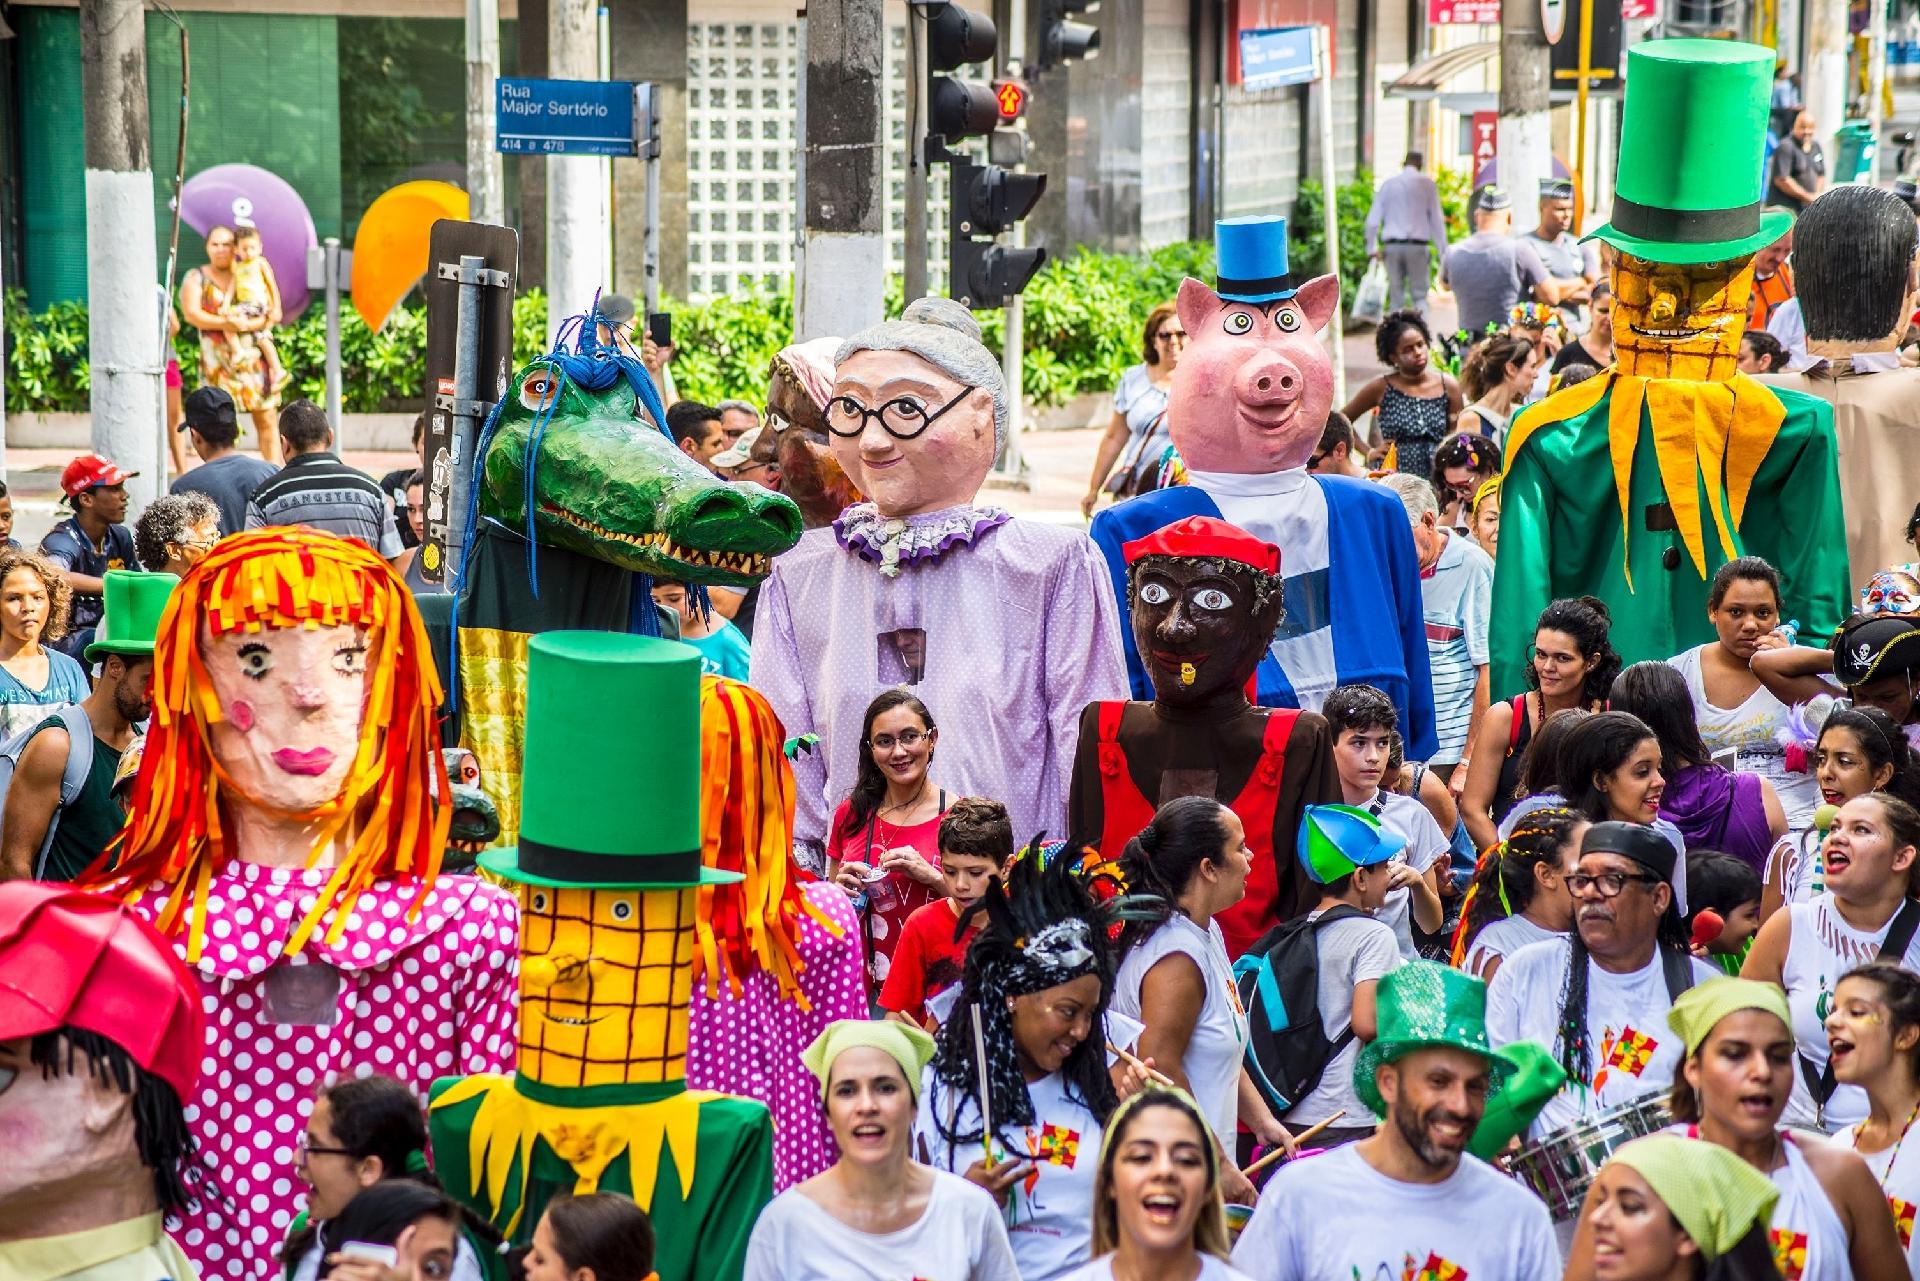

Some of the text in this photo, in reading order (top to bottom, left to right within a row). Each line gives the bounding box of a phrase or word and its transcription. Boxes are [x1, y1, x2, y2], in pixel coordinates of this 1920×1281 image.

[501, 84, 531, 98] Rua
[501, 99, 608, 117] Major Sertório
[501, 139, 521, 150] 414
[542, 140, 565, 151] 478
[279, 491, 362, 509] GANGSTER
